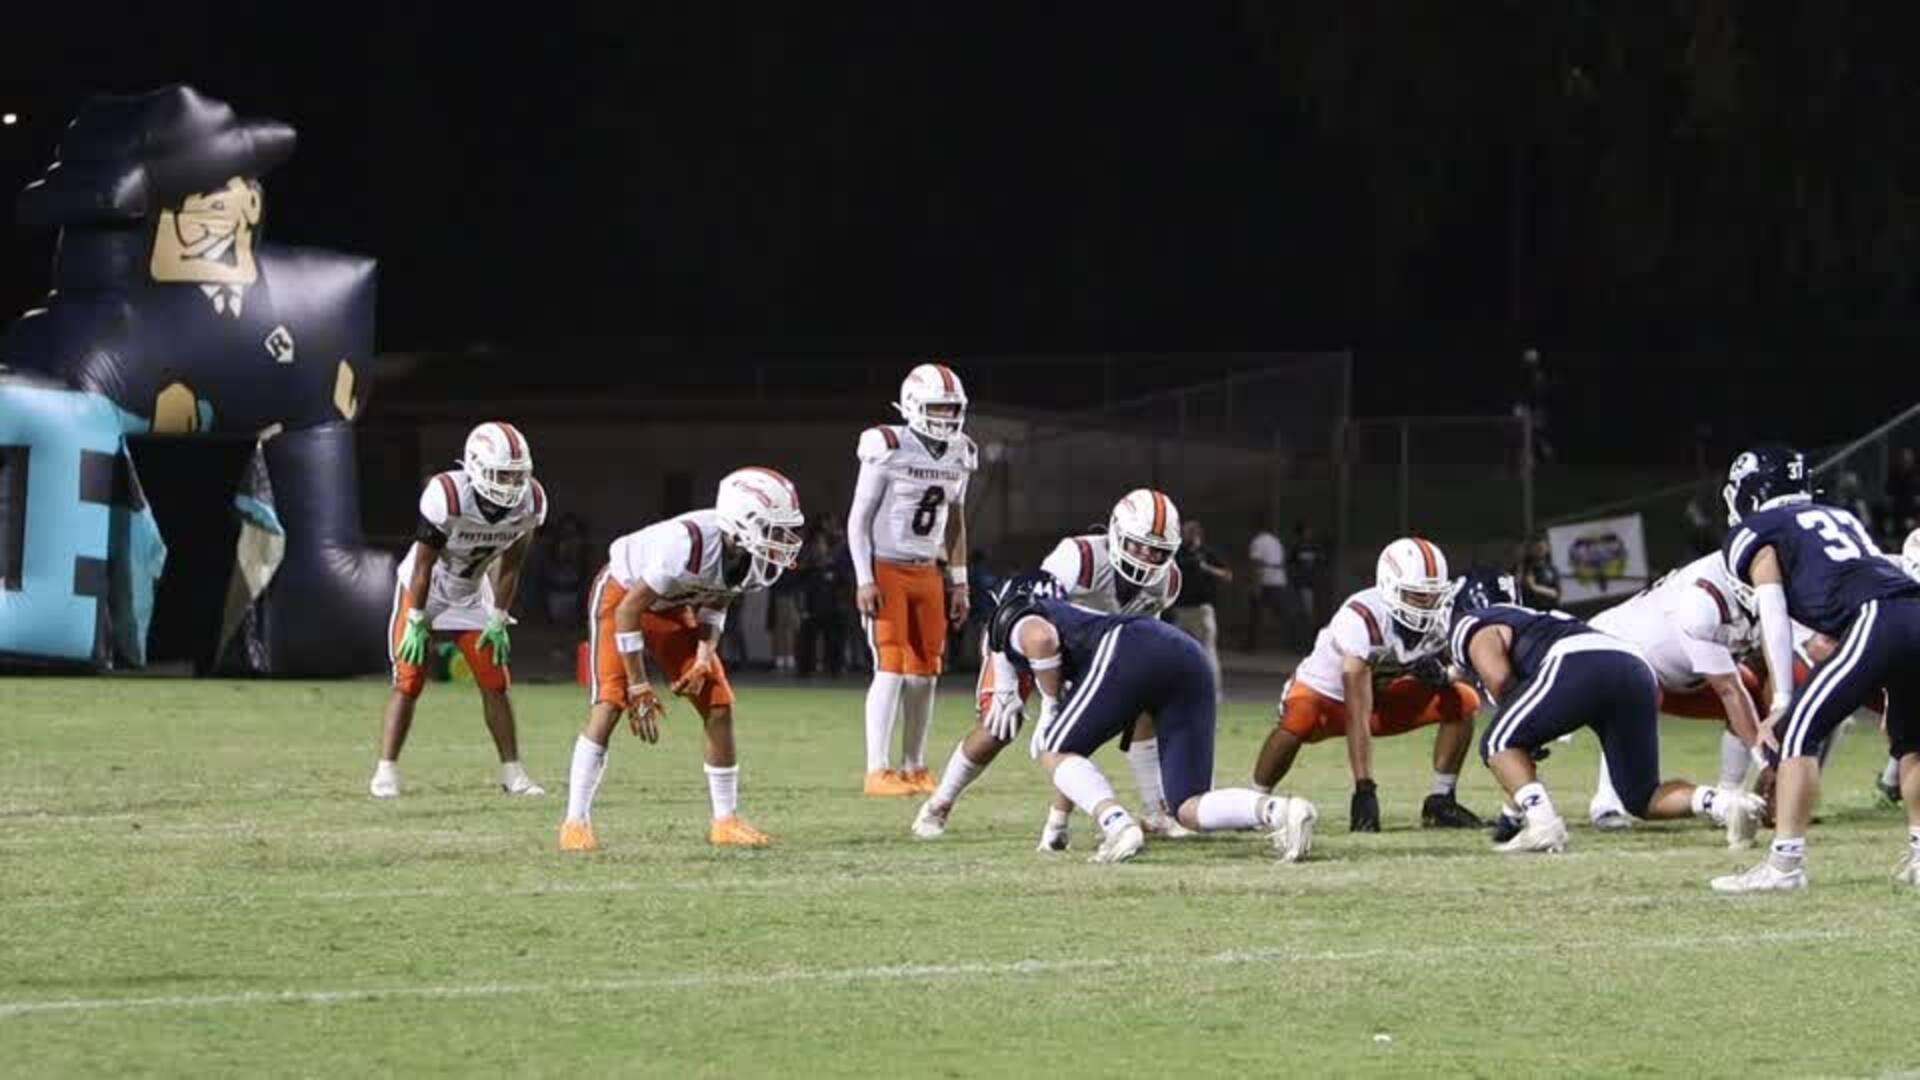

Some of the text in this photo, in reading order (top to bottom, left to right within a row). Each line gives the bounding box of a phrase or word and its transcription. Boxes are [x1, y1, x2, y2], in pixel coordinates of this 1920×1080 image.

[912, 485, 945, 536] 8
[1796, 509, 1883, 562] 37
[459, 545, 498, 578] 7
